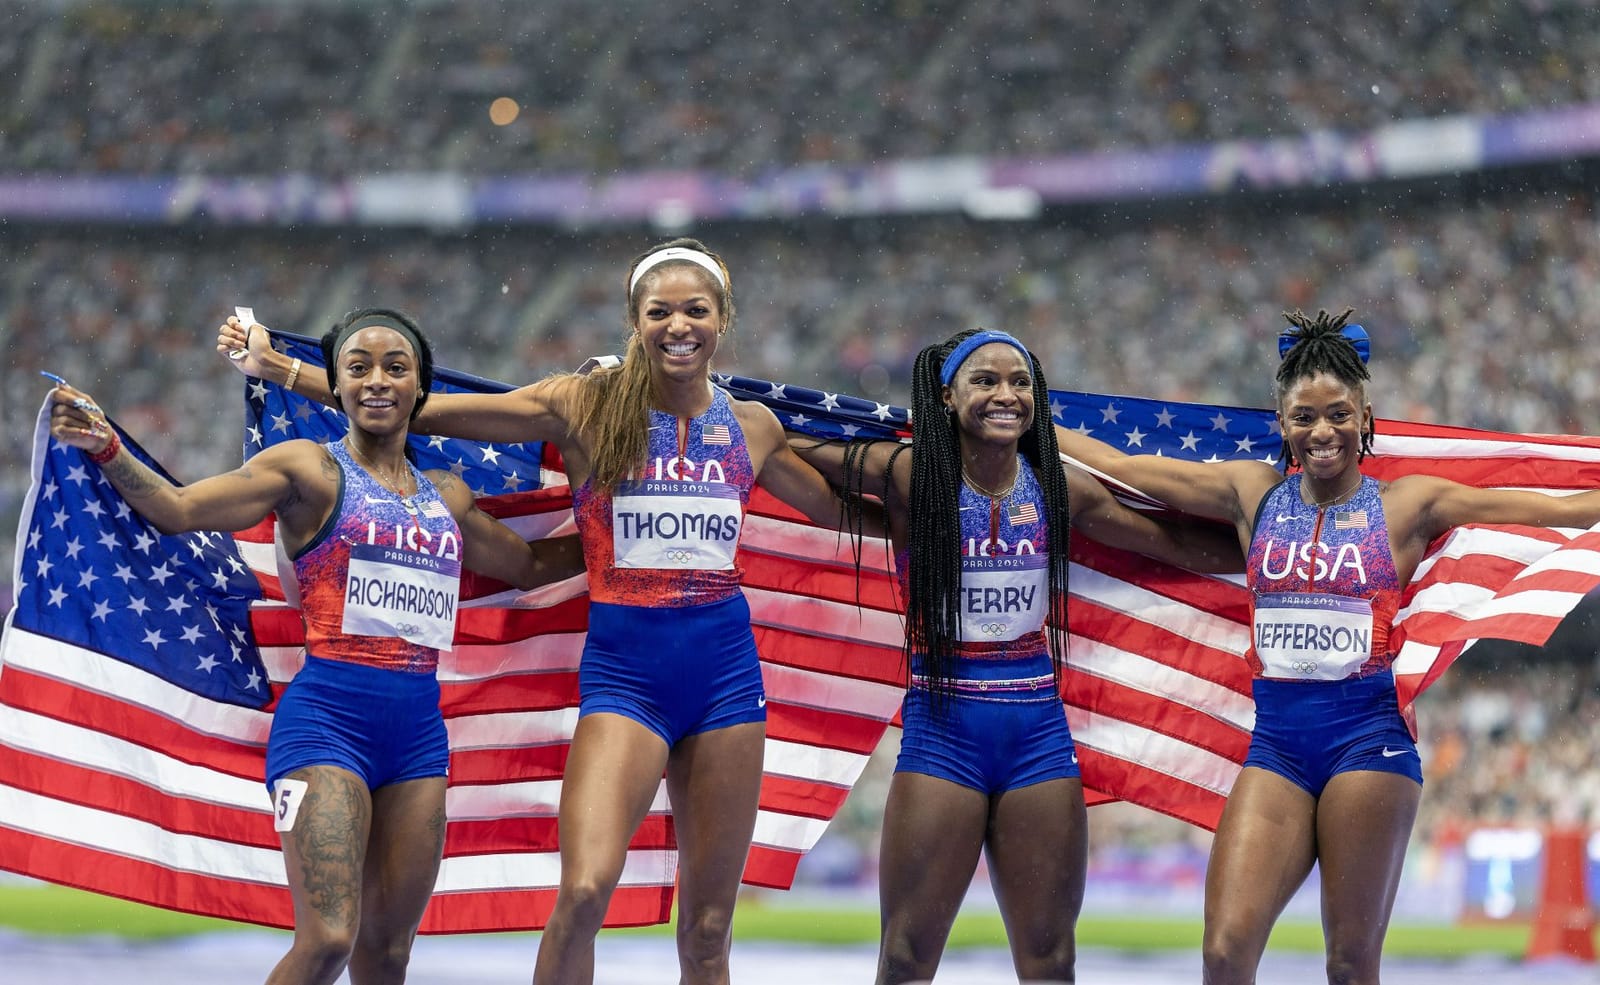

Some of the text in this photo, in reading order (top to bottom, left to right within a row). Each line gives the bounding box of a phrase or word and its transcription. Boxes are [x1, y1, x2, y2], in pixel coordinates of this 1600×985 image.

[647, 483, 710, 493] PARIS 2024
[617, 512, 738, 541] THOMAS
[385, 550, 440, 569] PARIS 2024
[963, 559, 1025, 568] PARIS 2024
[1263, 541, 1366, 584] USA
[348, 575, 455, 621] RICHARDSON
[961, 585, 1036, 613] ERRY
[1282, 596, 1341, 606] PARIS 2024
[1256, 623, 1368, 653] JEFFERSON
[278, 789, 292, 821] 5
